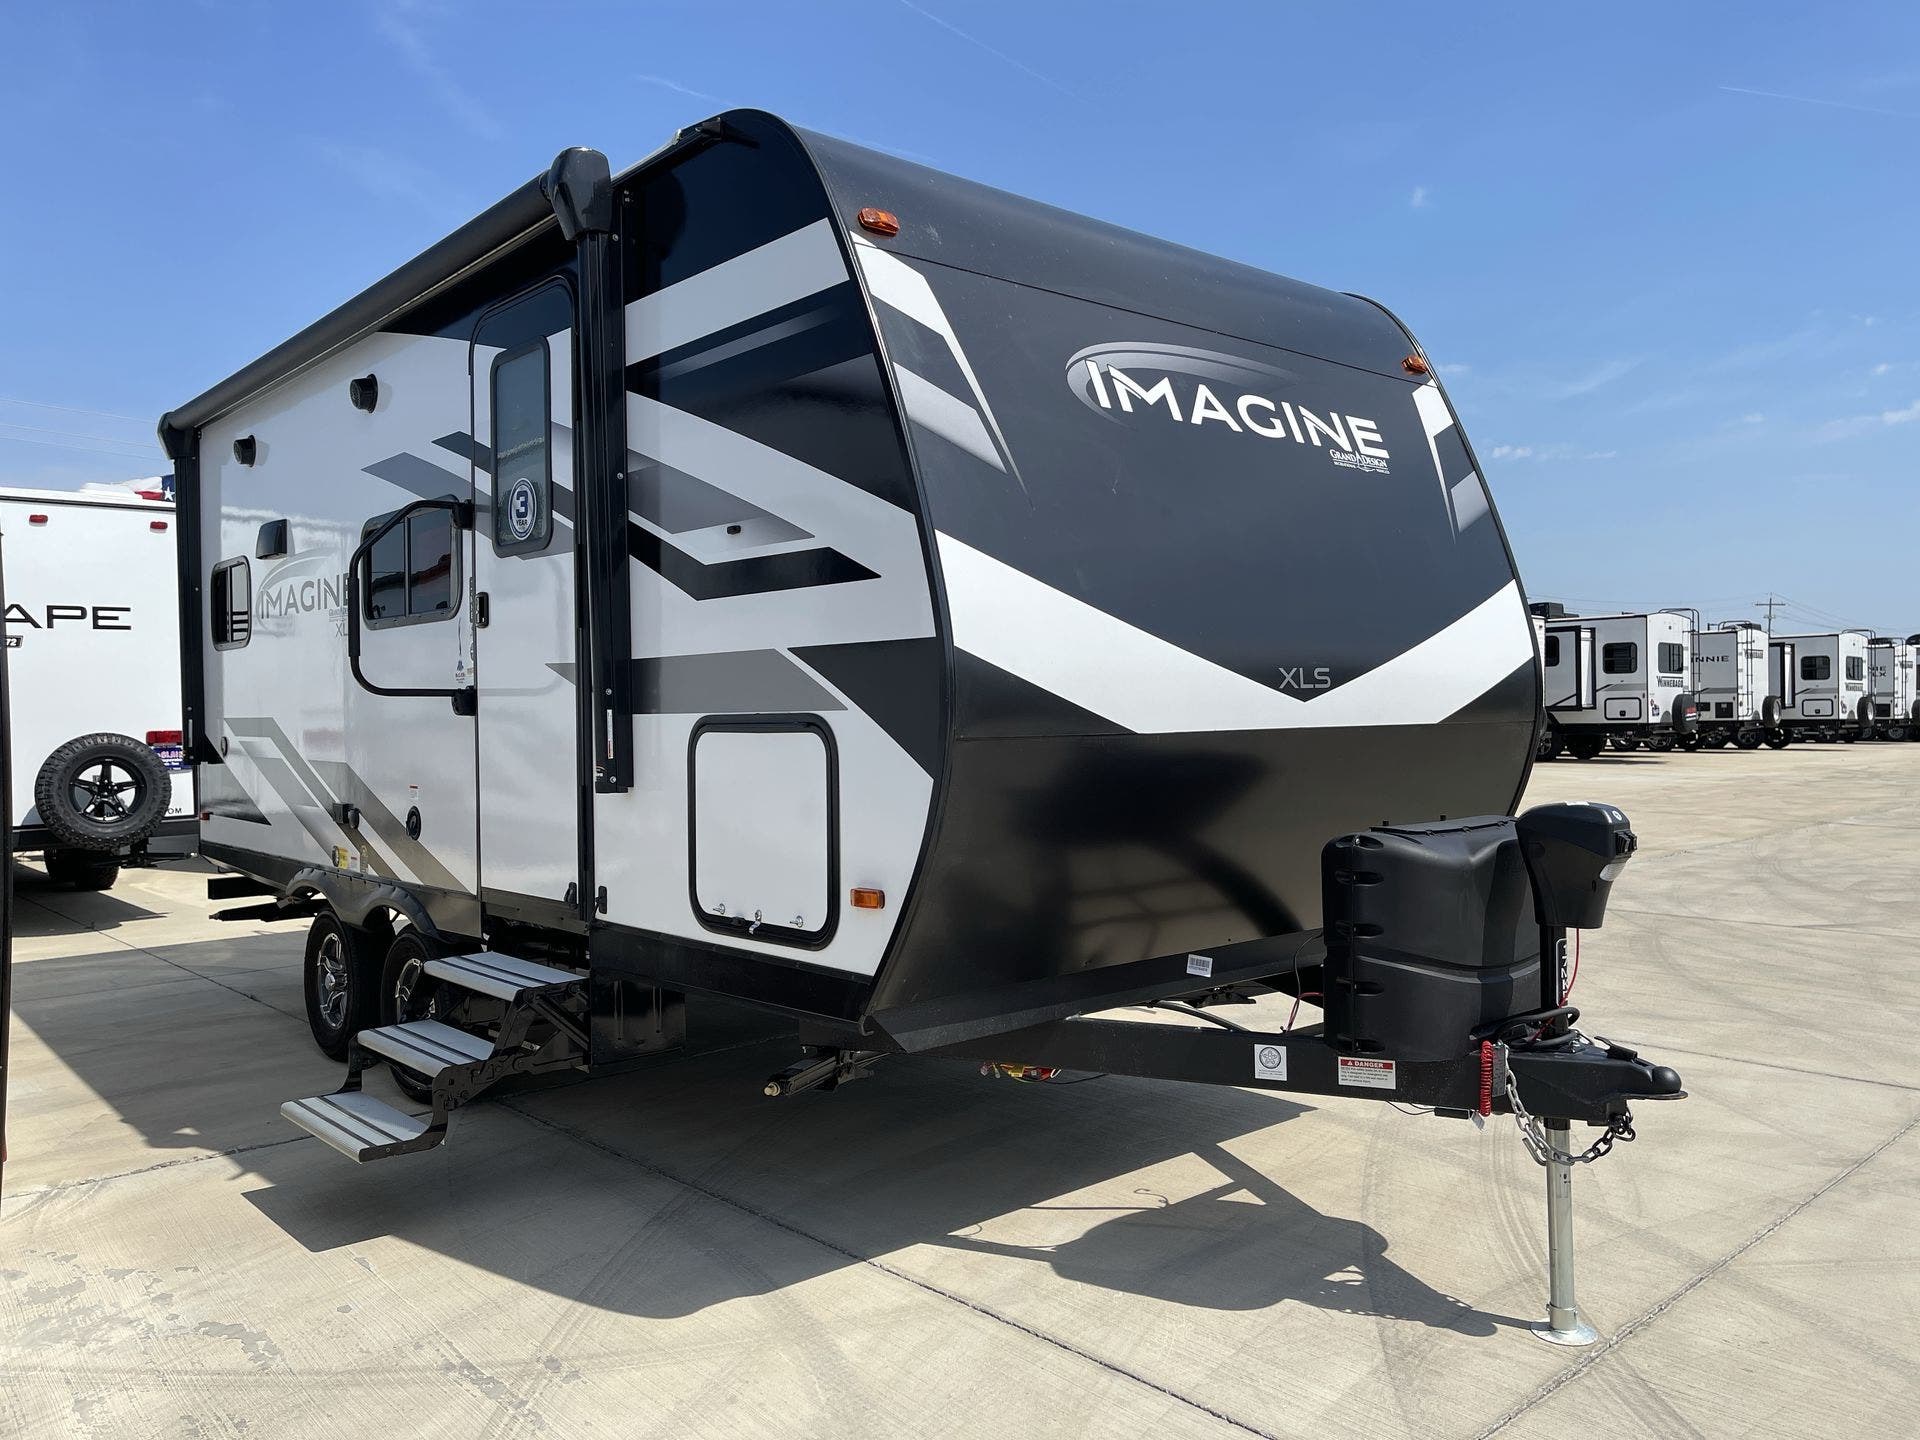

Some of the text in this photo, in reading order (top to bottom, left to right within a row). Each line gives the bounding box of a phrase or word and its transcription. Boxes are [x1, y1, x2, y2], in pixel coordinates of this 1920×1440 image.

[1085, 360, 1390, 458] IMAGINE
[1330, 449, 1356, 462] GRAND
[1360, 454, 1388, 468] DESIGN
[516, 490, 528, 518] 3
[1278, 667, 1331, 689] XLS
[1354, 1061, 1384, 1069] DANGER
